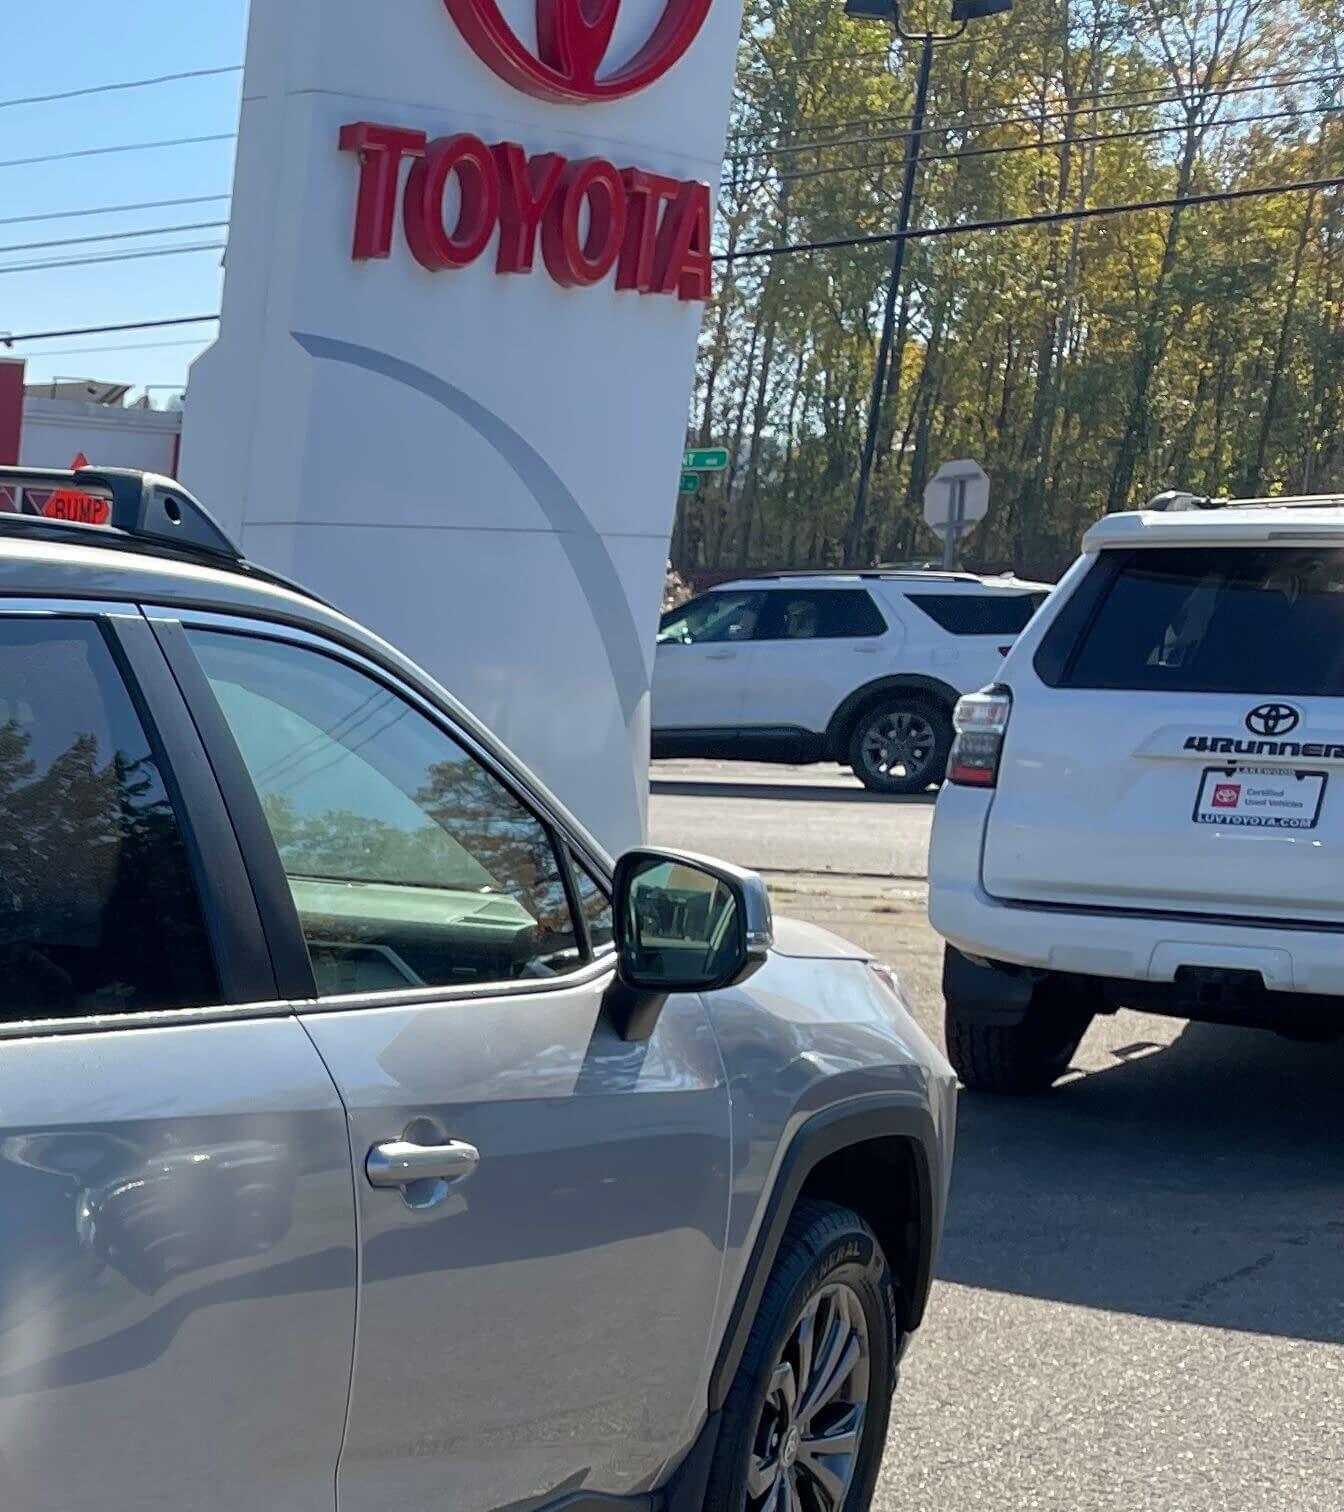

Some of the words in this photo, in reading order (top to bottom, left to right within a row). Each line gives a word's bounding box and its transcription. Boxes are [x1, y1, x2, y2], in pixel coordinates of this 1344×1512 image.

[338, 120, 712, 301] TOYOTA
[55, 496, 104, 523] BUMP
[1197, 813, 1312, 828] LUVTOYOTA.COM
